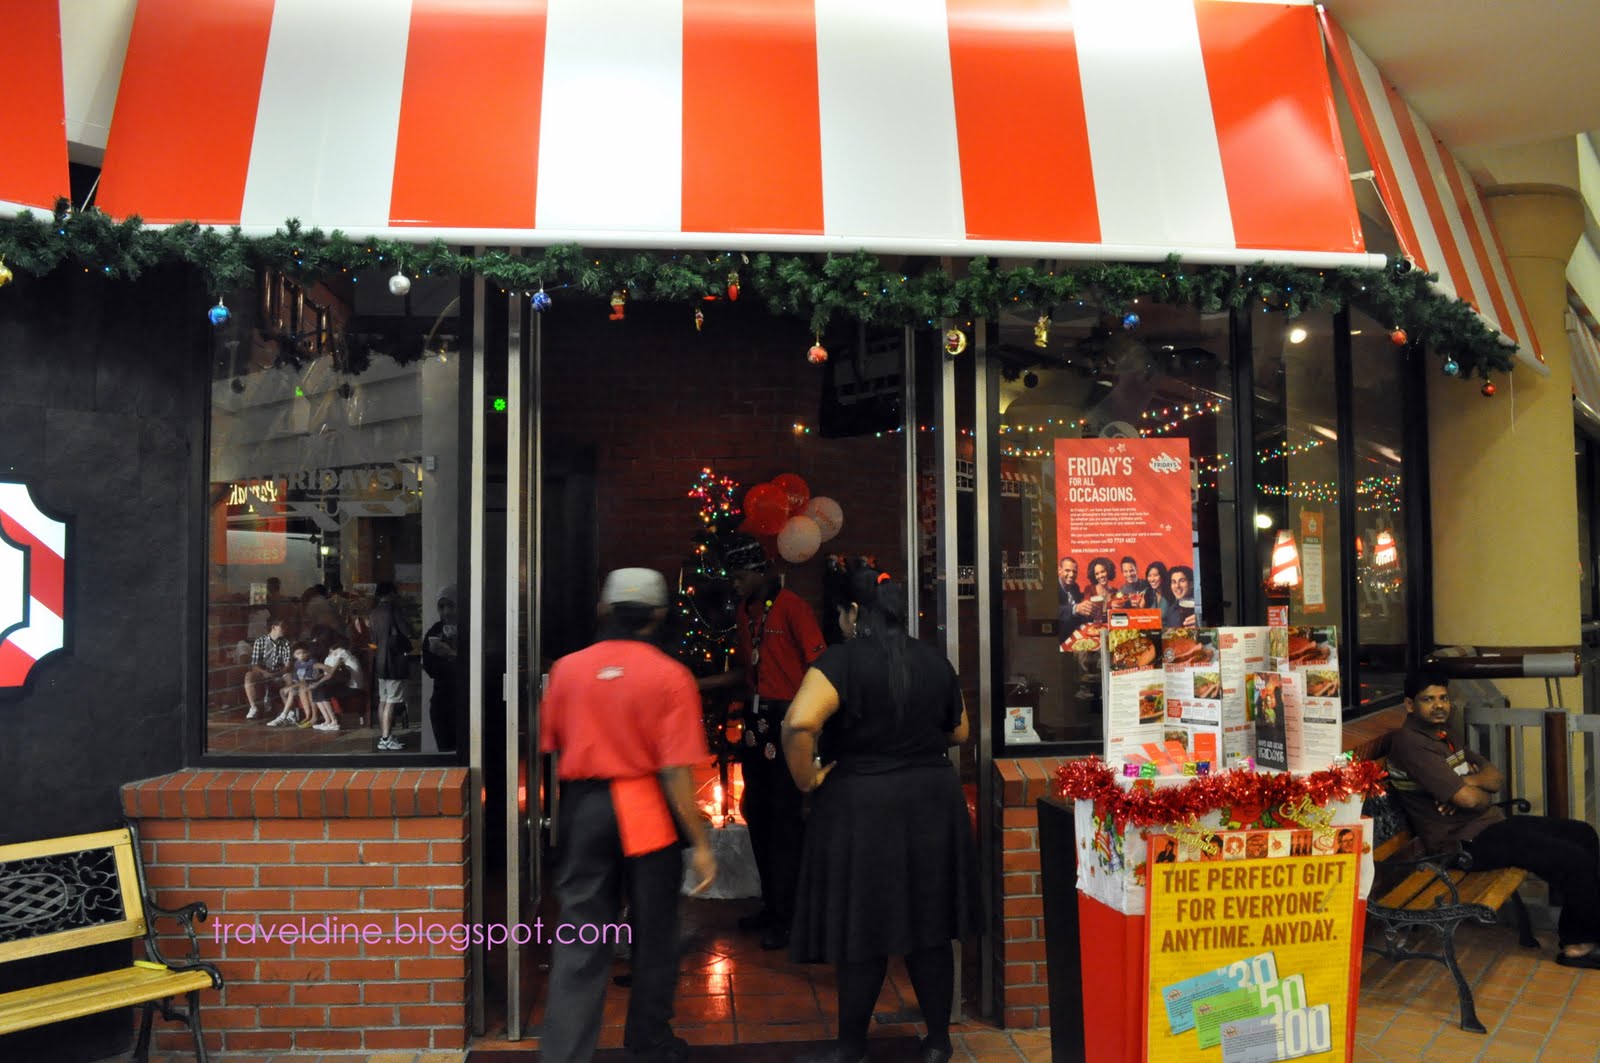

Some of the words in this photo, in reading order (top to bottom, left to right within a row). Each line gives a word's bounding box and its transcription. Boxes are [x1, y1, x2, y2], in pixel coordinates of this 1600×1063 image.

[1068, 457, 1133, 476] FRIDAY'S
[1069, 477, 1082, 486] FOR
[1083, 477, 1095, 486] ALL
[1069, 487, 1136, 502] OCCASIONS.
[1162, 869, 1200, 893] THE
[1207, 864, 1297, 890] PERFECT
[1302, 861, 1346, 886] GIFT
[1177, 898, 1216, 922] FOR
[1223, 891, 1328, 920] EVERYONE.
[1161, 925, 1254, 952] ANYTIME.
[1261, 919, 1338, 946] ANYDAY.
[1228, 951, 1278, 988] 20
[1259, 974, 1307, 1015] 50
[1269, 1004, 1331, 1060] 100
